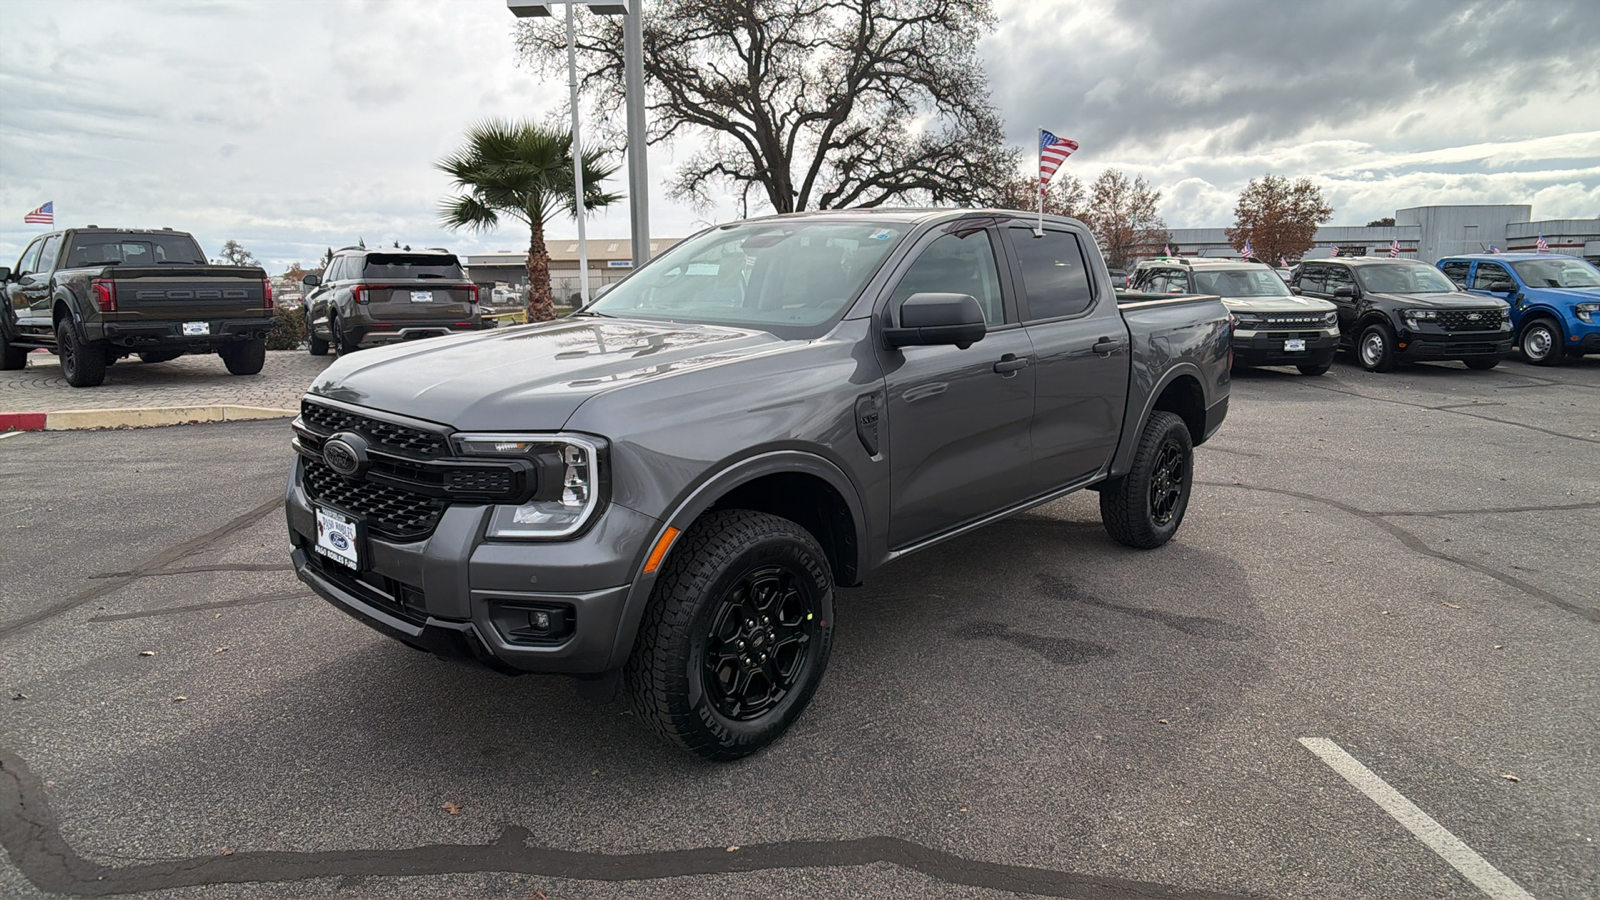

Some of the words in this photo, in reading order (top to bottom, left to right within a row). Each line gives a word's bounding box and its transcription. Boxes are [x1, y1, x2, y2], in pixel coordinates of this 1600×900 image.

[136, 289, 249, 299] FORD
[325, 444, 349, 469] Ford
[322, 516, 335, 531] PASO
[335, 521, 354, 542] ROBLES
[314, 544, 327, 556] PASO
[327, 550, 344, 565] ROBLES
